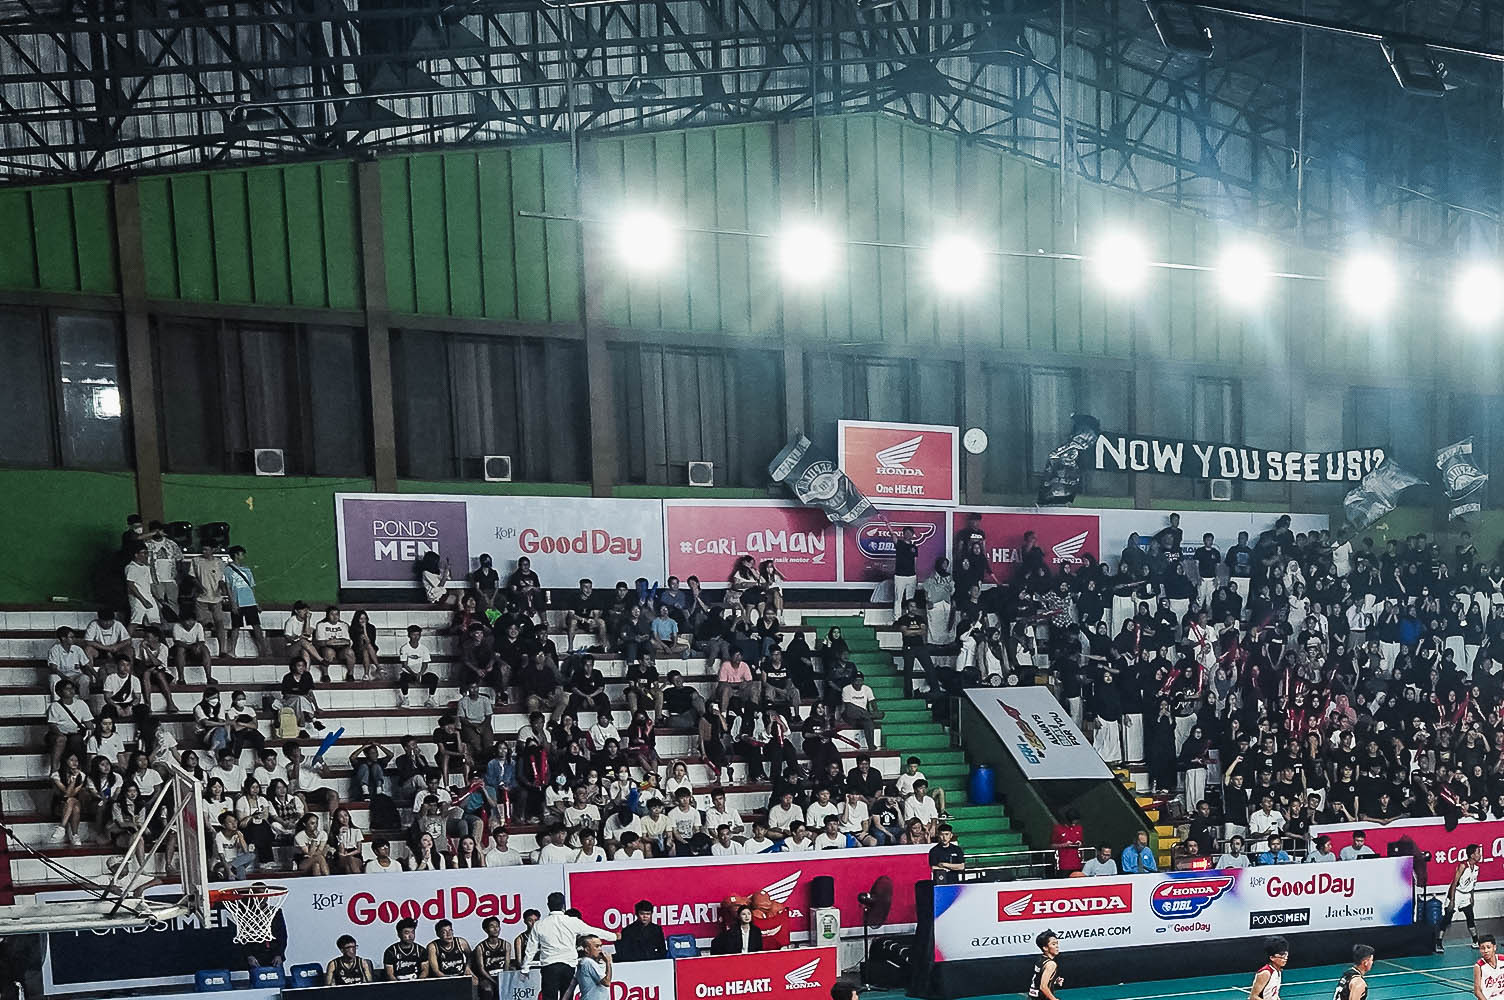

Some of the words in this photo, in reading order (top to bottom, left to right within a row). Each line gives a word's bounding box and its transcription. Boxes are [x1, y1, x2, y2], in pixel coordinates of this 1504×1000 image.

[1095, 434, 1183, 474] NOW
[1192, 444, 1260, 480] YOU
[1266, 451, 1321, 481] SEE
[876, 467, 924, 476] HONDA
[876, 484, 893, 494] One
[373, 520, 438, 537] POND'S
[374, 541, 438, 561] MEN
[519, 528, 587, 555] Good
[591, 529, 643, 562] Day
[992, 548, 1024, 563] HEA
[1048, 711, 1066, 728] YOU
[1172, 886, 1214, 896] HONDA
[1266, 875, 1316, 898] Good
[1318, 873, 1355, 898] Day
[347, 889, 445, 926] Good
[450, 886, 521, 924] Day
[1032, 895, 1127, 915] HONDA
[1172, 900, 1193, 911] DBL
[1324, 904, 1374, 919] Jackson
[1252, 914, 1283, 925] POND'S
[1286, 912, 1308, 924] MEN
[1056, 926, 1132, 940] ZAWEAR.COM
[1174, 923, 1195, 933] Good
[1195, 922, 1211, 932] Day
[695, 983, 724, 998] One
[785, 981, 822, 990] HONDA
